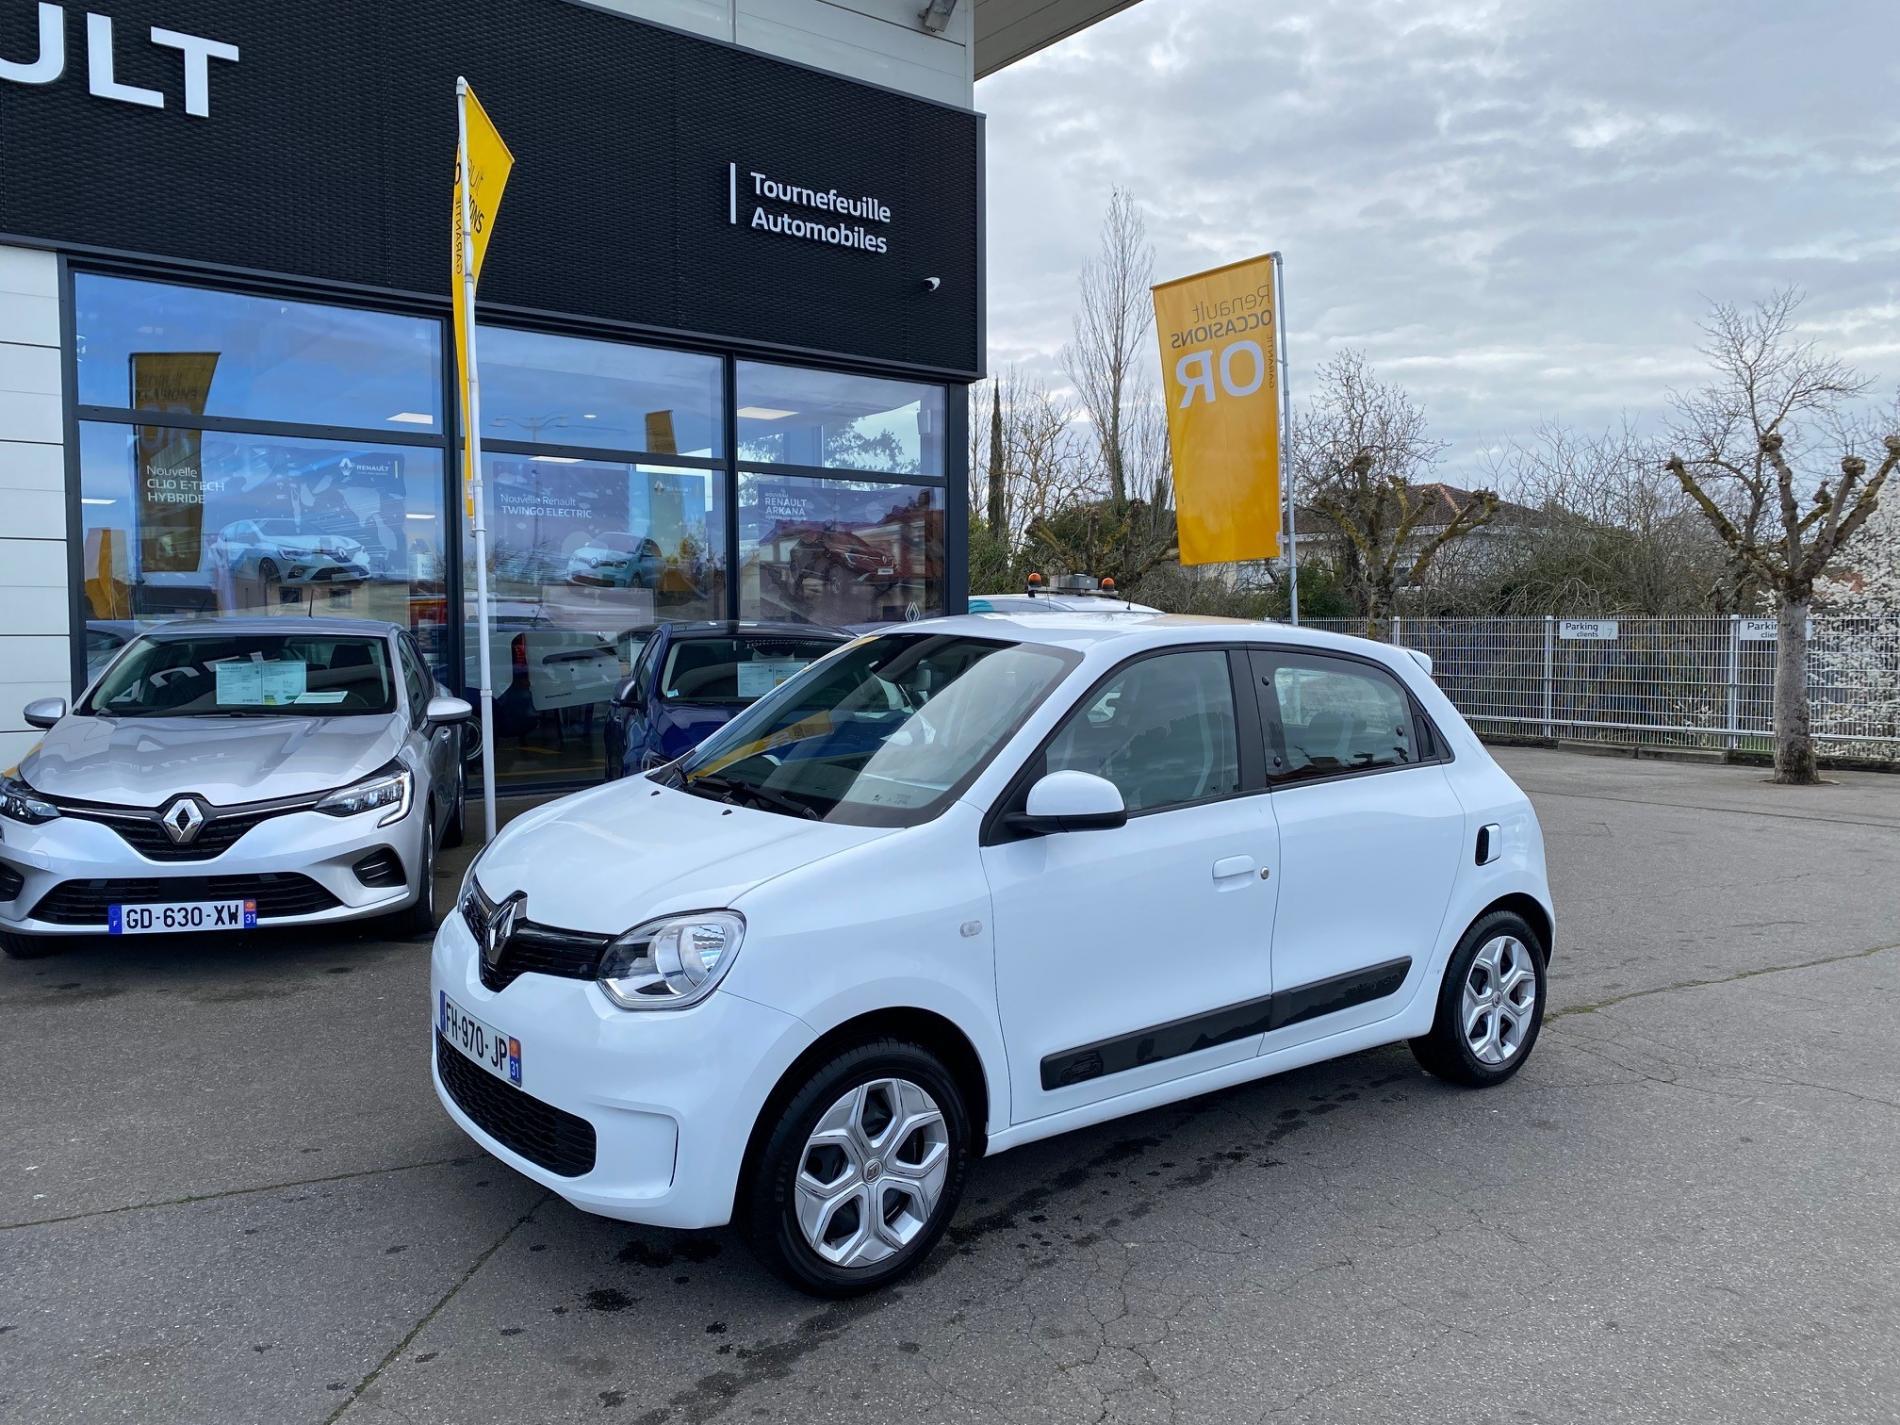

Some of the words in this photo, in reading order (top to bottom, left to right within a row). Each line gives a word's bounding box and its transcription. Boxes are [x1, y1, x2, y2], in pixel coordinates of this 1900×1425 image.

[750, 171, 892, 223] Tournefeuille
[751, 206, 888, 254] Automobiles
[146, 464, 198, 478] Nouvelle
[146, 478, 177, 490] CLIO
[180, 480, 225, 492] E-TECH
[147, 492, 207, 504] HYBRIDE
[542, 496, 576, 507] Renault
[764, 497, 808, 508] RENAULT
[501, 505, 545, 517] TWINGO
[546, 507, 593, 519] ELECTRIC
[765, 506, 806, 516] ARKANA
[1565, 622, 1599, 632] Parking
[1746, 621, 1778, 631] Parki
[126, 904, 239, 930] GD-630-XW
[245, 913, 257, 924] 31
[510, 1060, 520, 1079] 31
